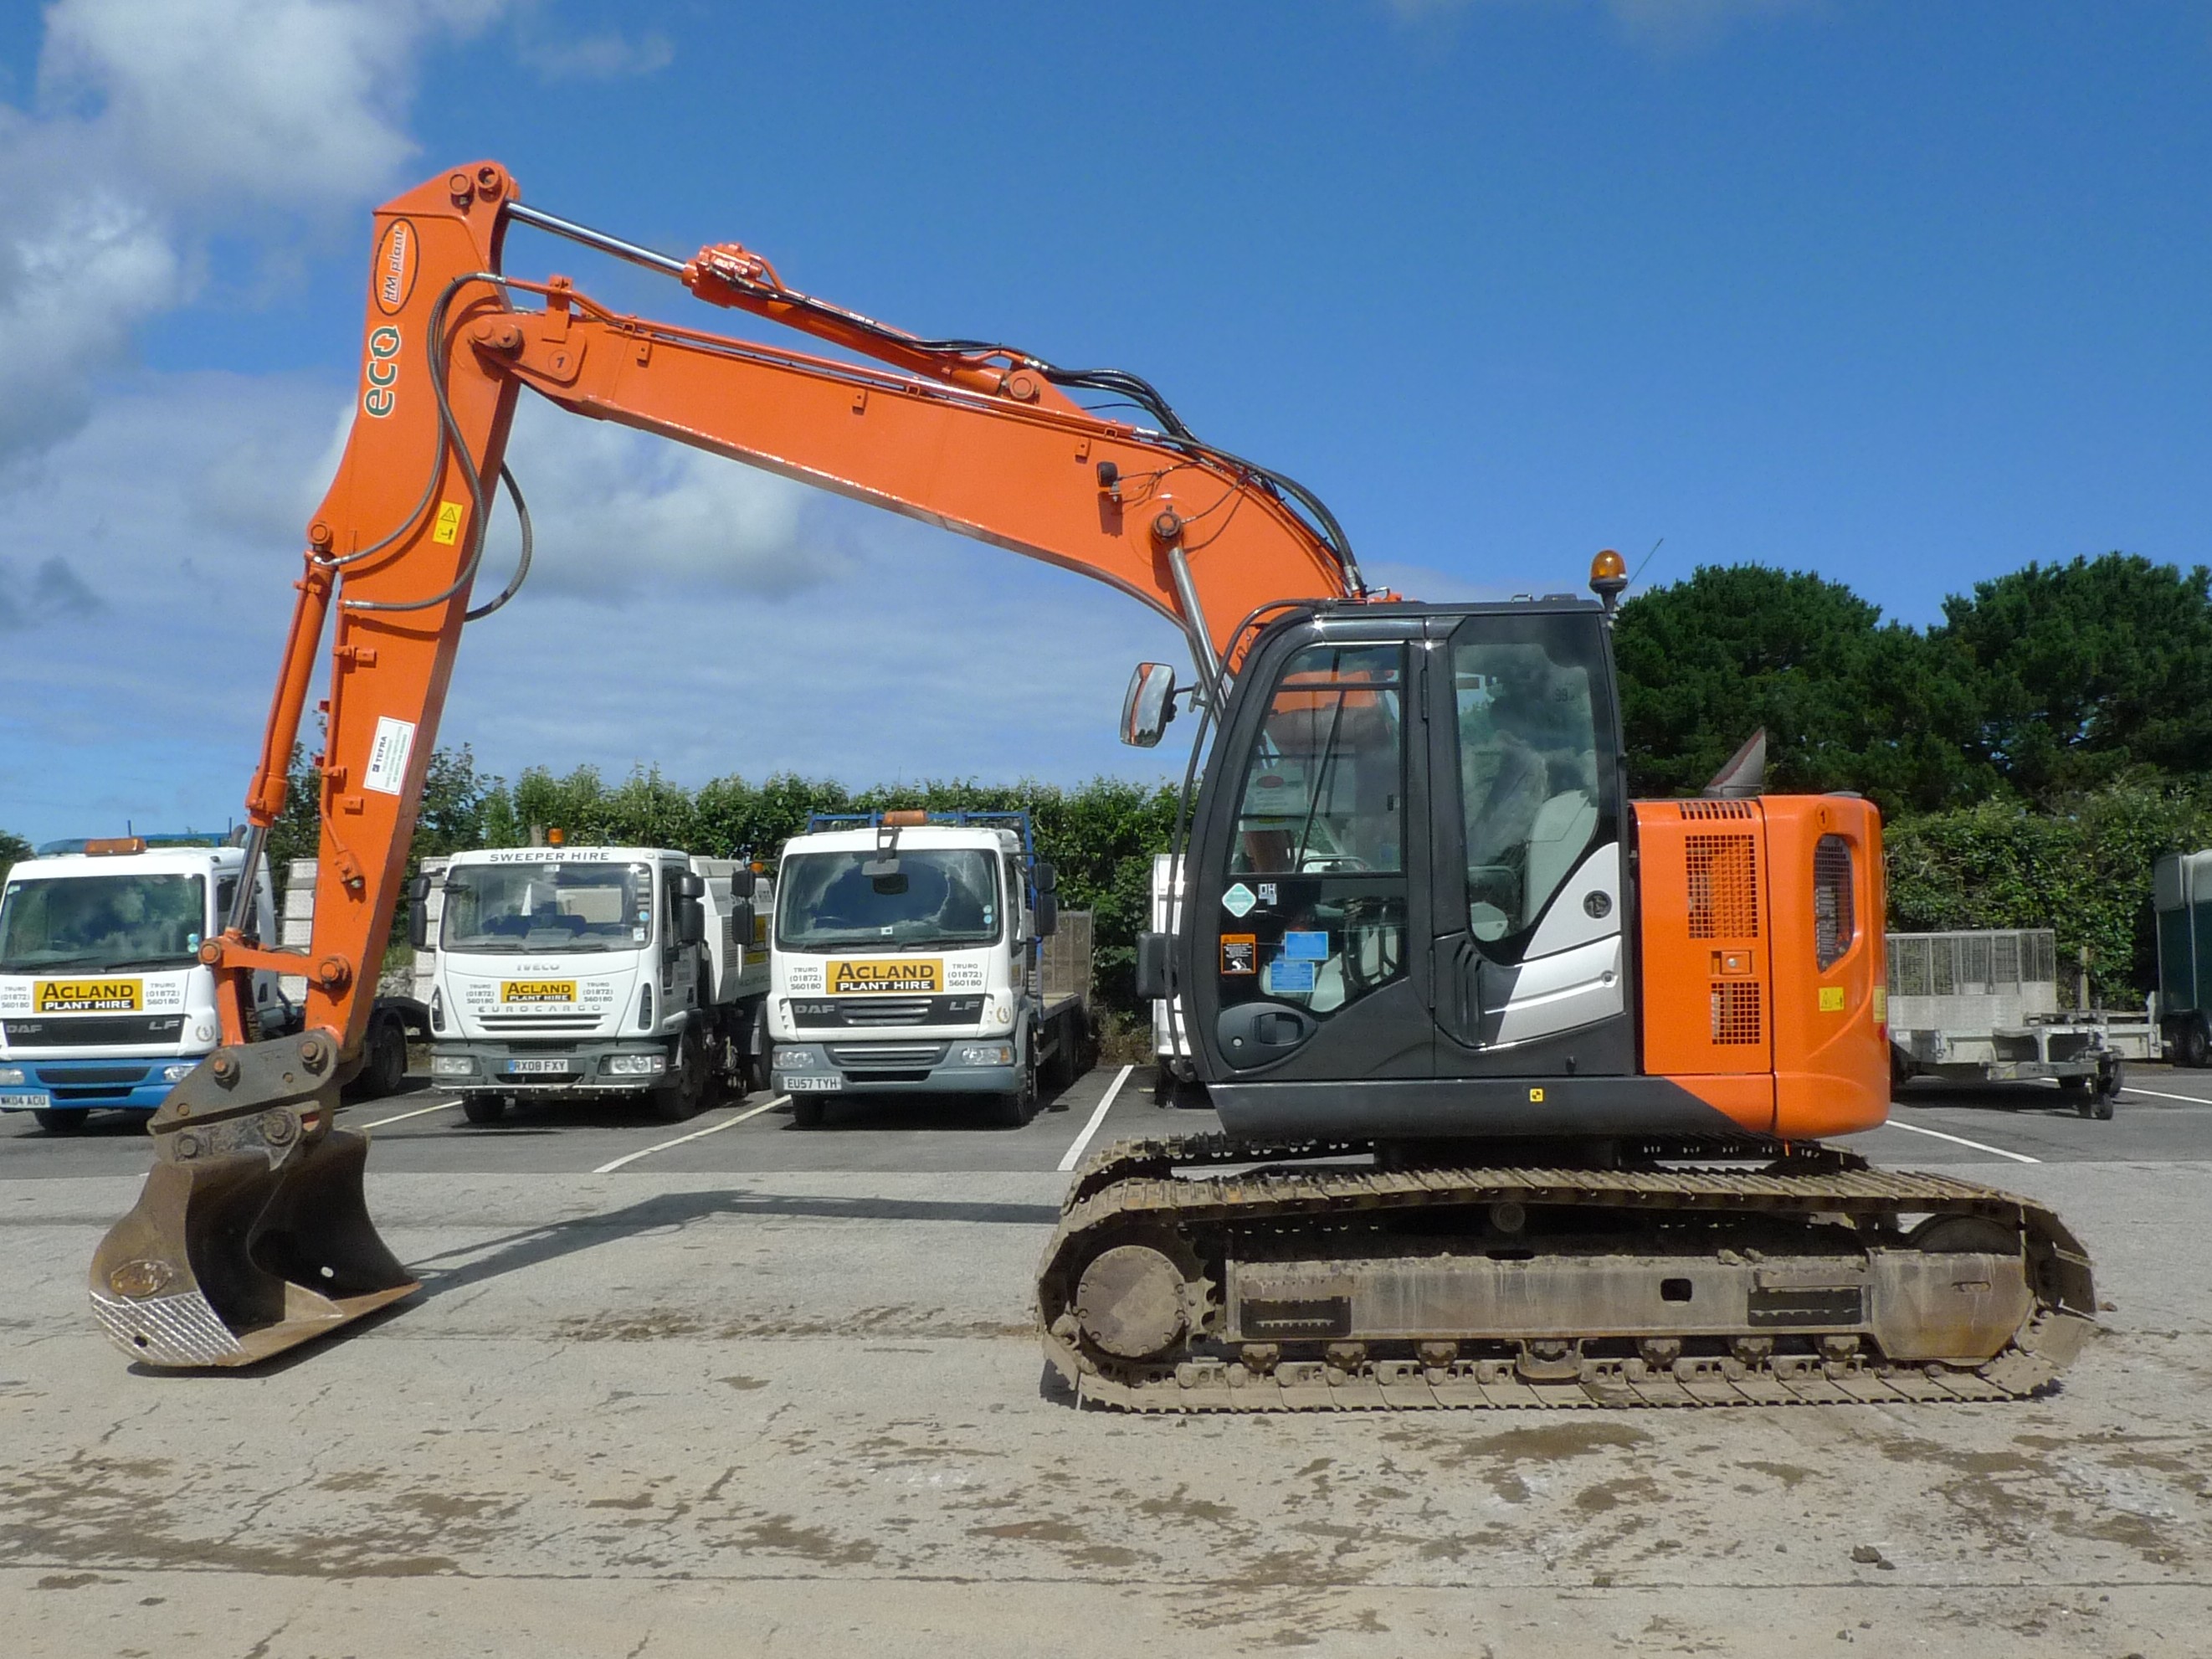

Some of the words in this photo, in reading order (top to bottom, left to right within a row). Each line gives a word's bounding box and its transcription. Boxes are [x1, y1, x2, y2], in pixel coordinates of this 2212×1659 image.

[382, 275, 398, 304] HM
[390, 228, 405, 272] plant
[489, 852, 566, 862] SWEEPER
[571, 851, 610, 860] HIRE
[516, 963, 560, 972] IVECO
[789, 973, 822, 983] (01872)
[947, 970, 983, 978] (01872)
[790, 982, 822, 990] 560180
[839, 981, 890, 991] PLANT
[893, 980, 932, 990] HIRE
[947, 978, 983, 987] 560180
[146, 989, 181, 998] (01872)
[44, 1000, 92, 1010] PLANT
[95, 999, 131, 1009] HIRE
[147, 998, 180, 1006] 560180
[794, 1004, 835, 1014] DAF
[948, 1000, 980, 1010] LF
[477, 1004, 601, 1014] EUROCARGO
[6, 1024, 43, 1034] DAF
[148, 1020, 180, 1030] LF
[515, 1061, 541, 1071] RX08
[544, 1061, 566, 1071] FXY
[788, 1078, 813, 1089] EU57
[816, 1078, 837, 1088] TYH
